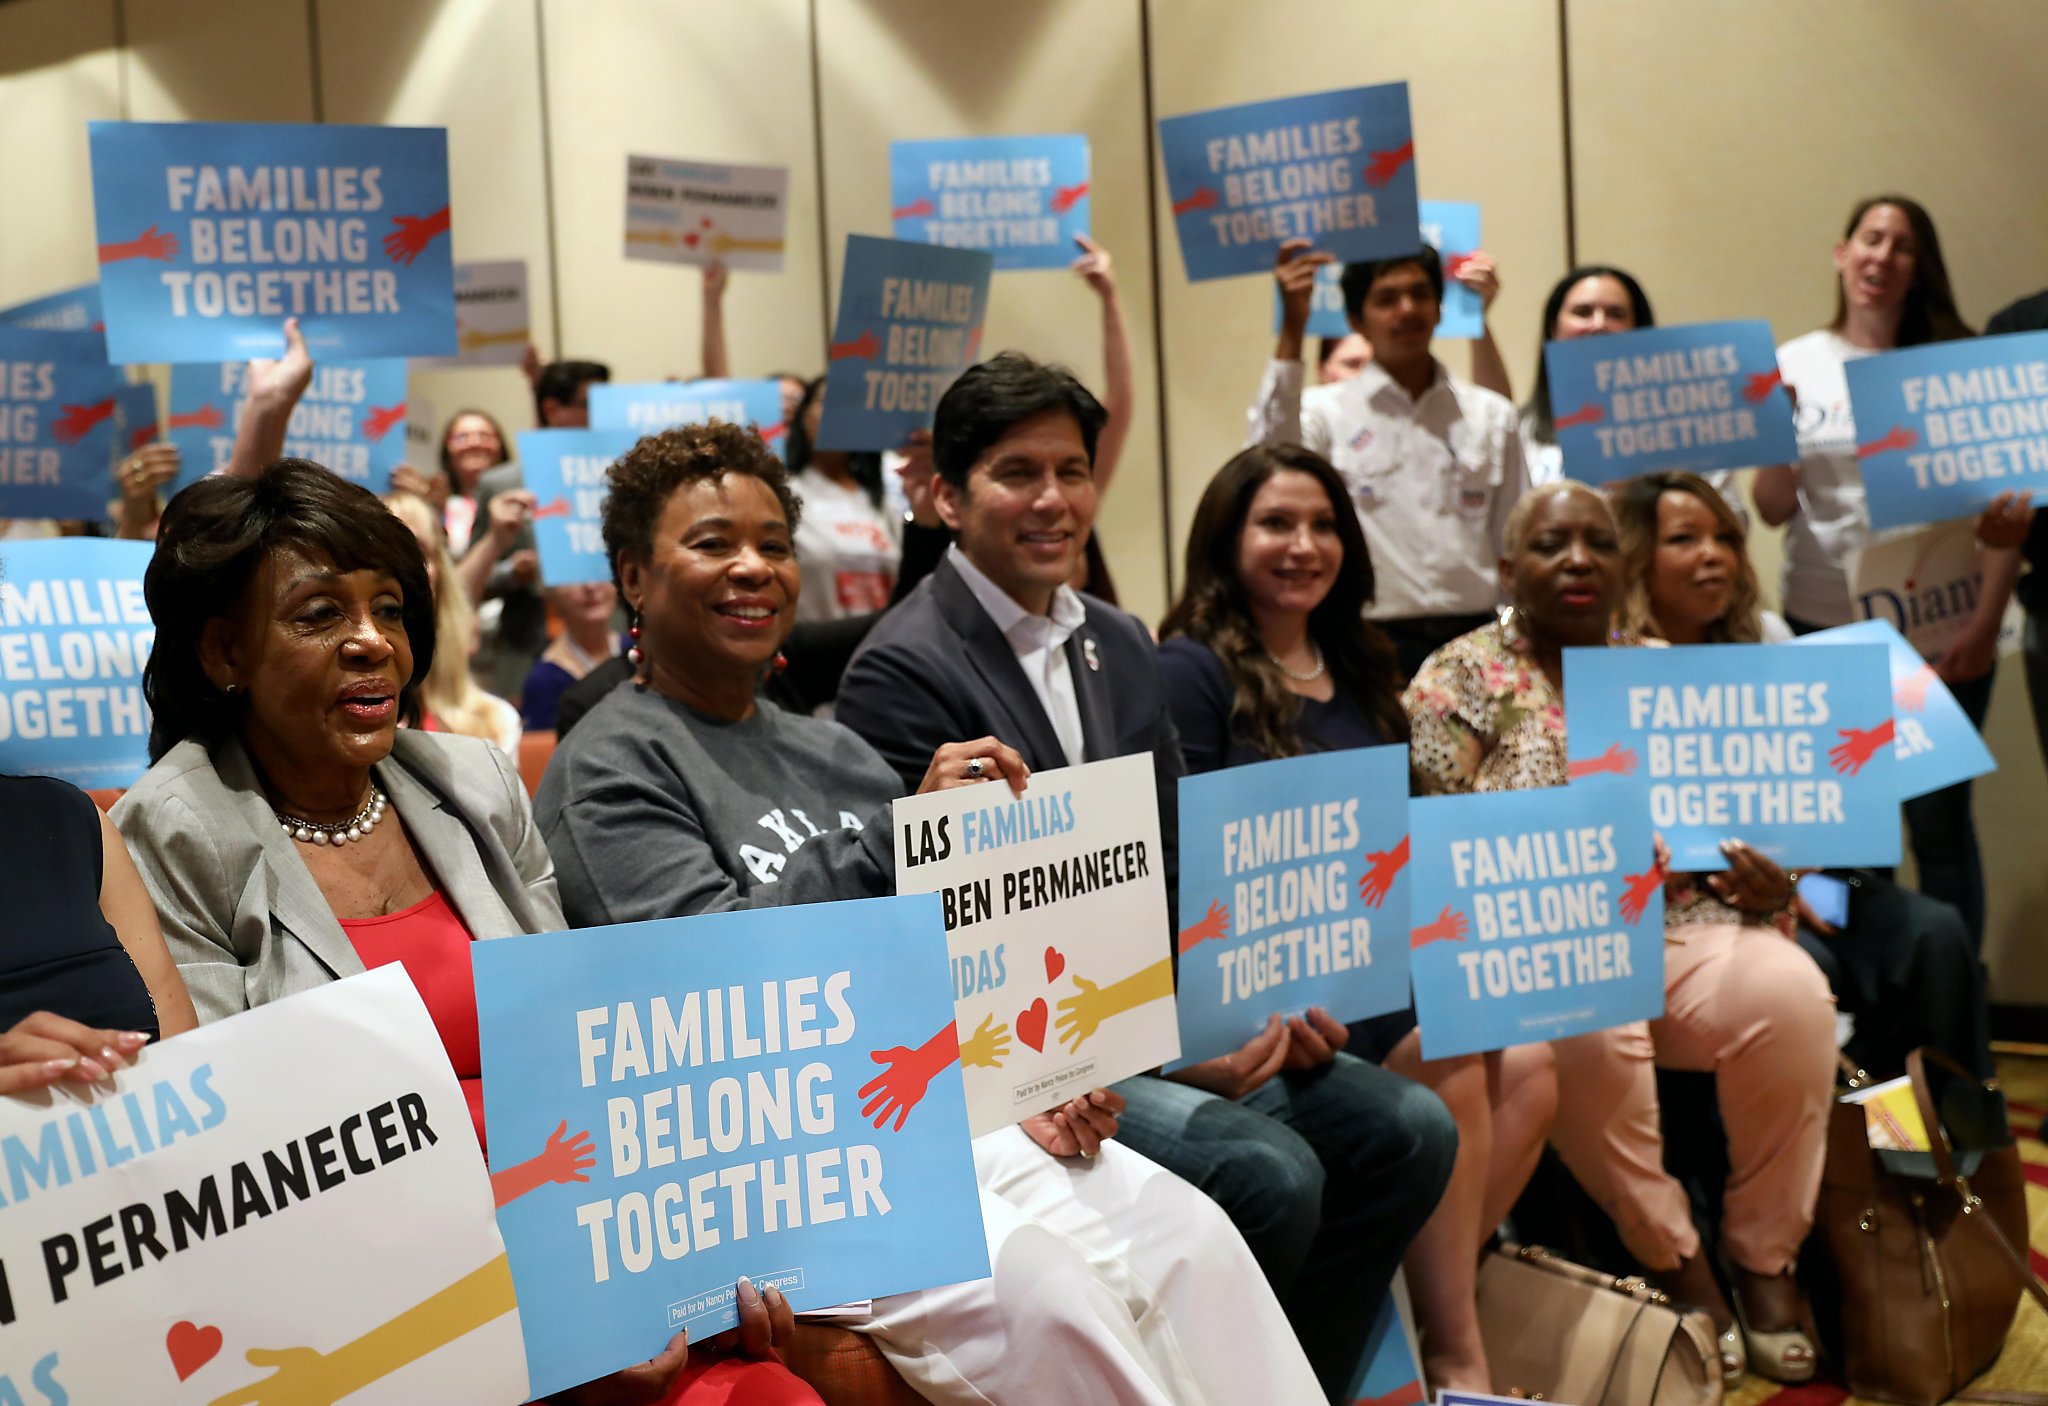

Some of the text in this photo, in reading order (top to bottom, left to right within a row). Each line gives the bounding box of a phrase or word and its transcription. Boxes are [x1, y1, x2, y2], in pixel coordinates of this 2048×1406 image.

[1206, 117, 1362, 174] FAMILIES
[166, 166, 383, 212] FAMILIES
[1224, 159, 1351, 208] BELONG
[190, 218, 368, 264] BELONG
[1210, 194, 1379, 247] TOGETHER
[161, 271, 400, 318] TOGETHER
[1594, 344, 1740, 391] FAMILIES
[1611, 379, 1732, 423] BELONG
[1924, 396, 2048, 449] BELON
[1594, 408, 1757, 458] TOGETHER
[1627, 682, 1831, 730] FAMILIES
[1648, 732, 1814, 778] BELONG
[904, 790, 1075, 868] LAS FAMILIAS
[1650, 780, 1845, 828] OGETHER
[1222, 797, 1360, 876] FAMILIES
[1450, 824, 1618, 888] FAMILIES
[941, 840, 1150, 932] BEN PERMANECER
[1234, 860, 1348, 937] BELONG
[1473, 880, 1611, 942] BELONG
[951, 943, 1006, 1001] IDAS
[1217, 917, 1372, 1006] TOGETHER
[1458, 932, 1632, 1001] TOGETHER
[576, 970, 856, 1088] FAMILIES
[0, 1063, 227, 1209] MILIAS
[607, 1062, 835, 1178] BELONG
[40, 1091, 439, 1305] PERMANECER
[576, 1144, 892, 1284] TOGETHER
[672, 1305, 687, 1320] Paid
[687, 1303, 697, 1314] for
[697, 1300, 705, 1312] by
[705, 1293, 725, 1308] Nancy
[725, 1287, 737, 1300] Pel
[759, 1275, 798, 1291] Cgress
